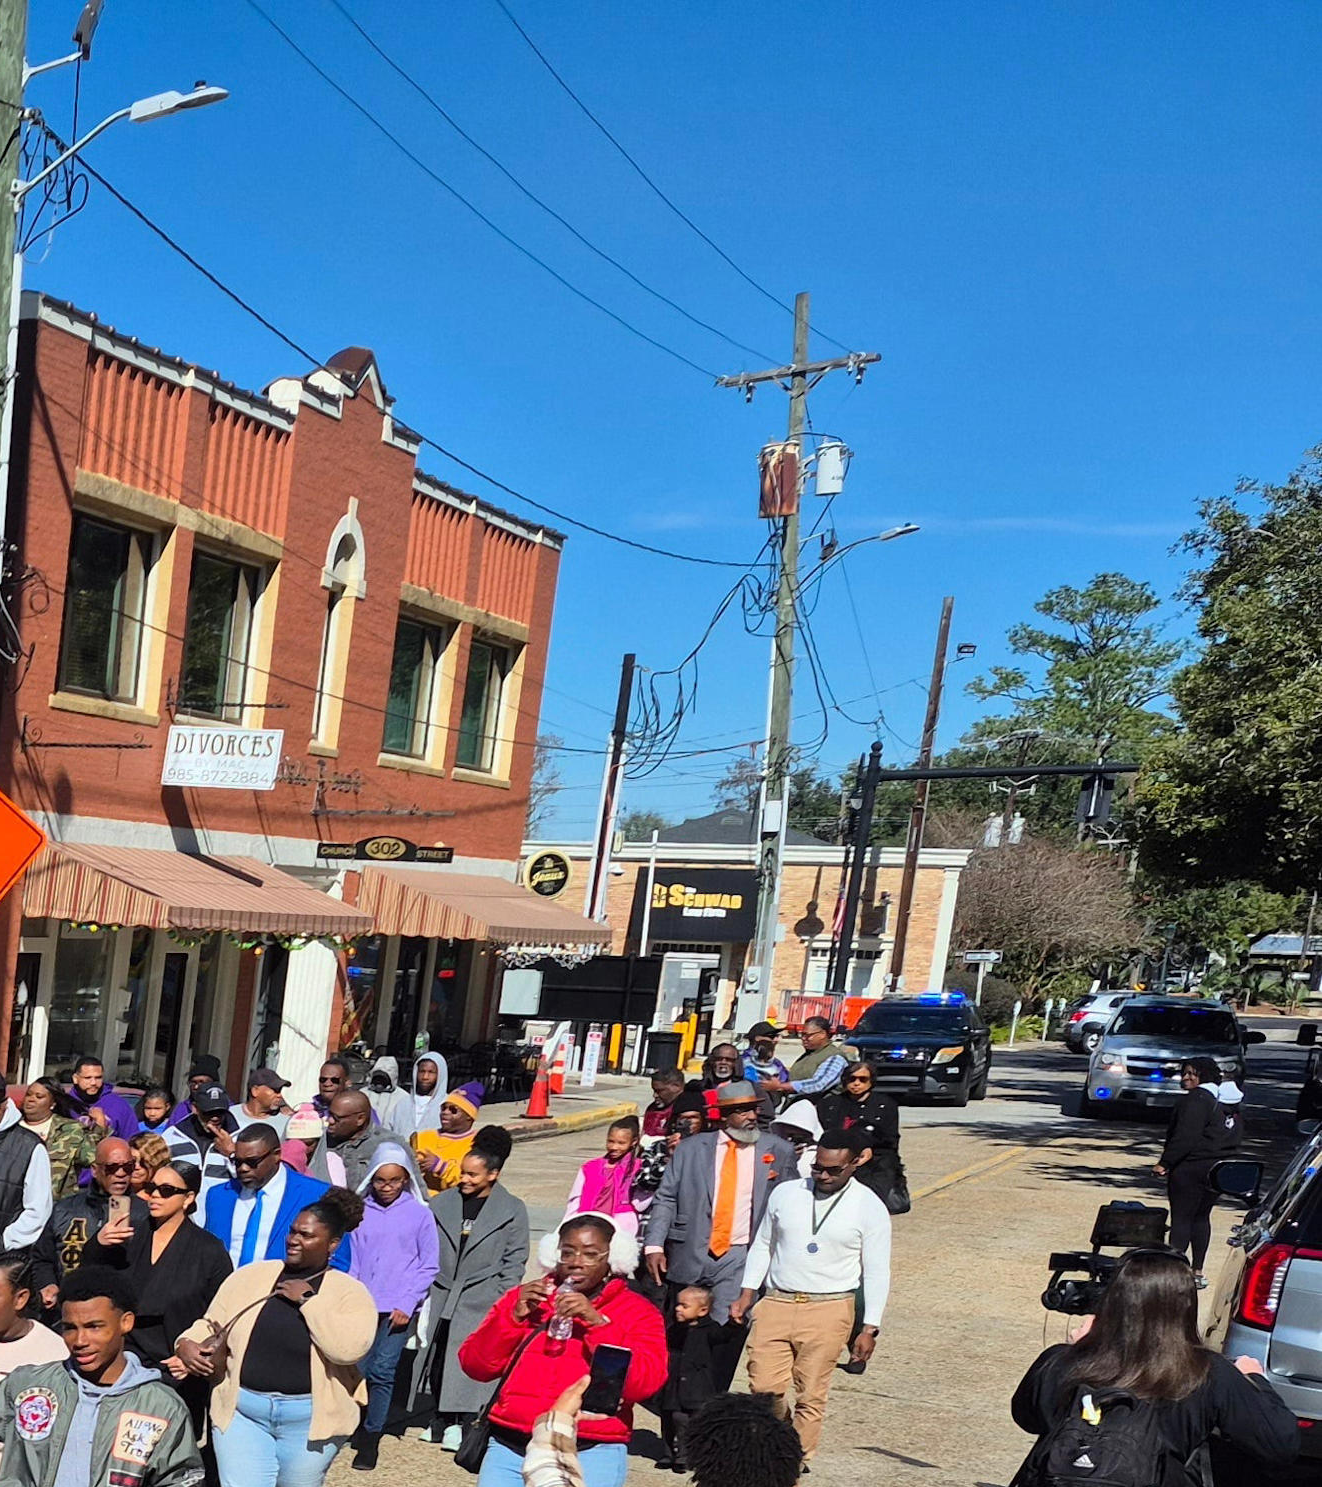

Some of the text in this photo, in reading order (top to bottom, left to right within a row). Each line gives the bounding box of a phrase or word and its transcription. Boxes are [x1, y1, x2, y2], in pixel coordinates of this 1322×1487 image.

[173, 732, 275, 758] DIVORCES
[165, 767, 269, 785] 985-872-2884
[370, 841, 401, 856] 302
[417, 849, 449, 859] STREET
